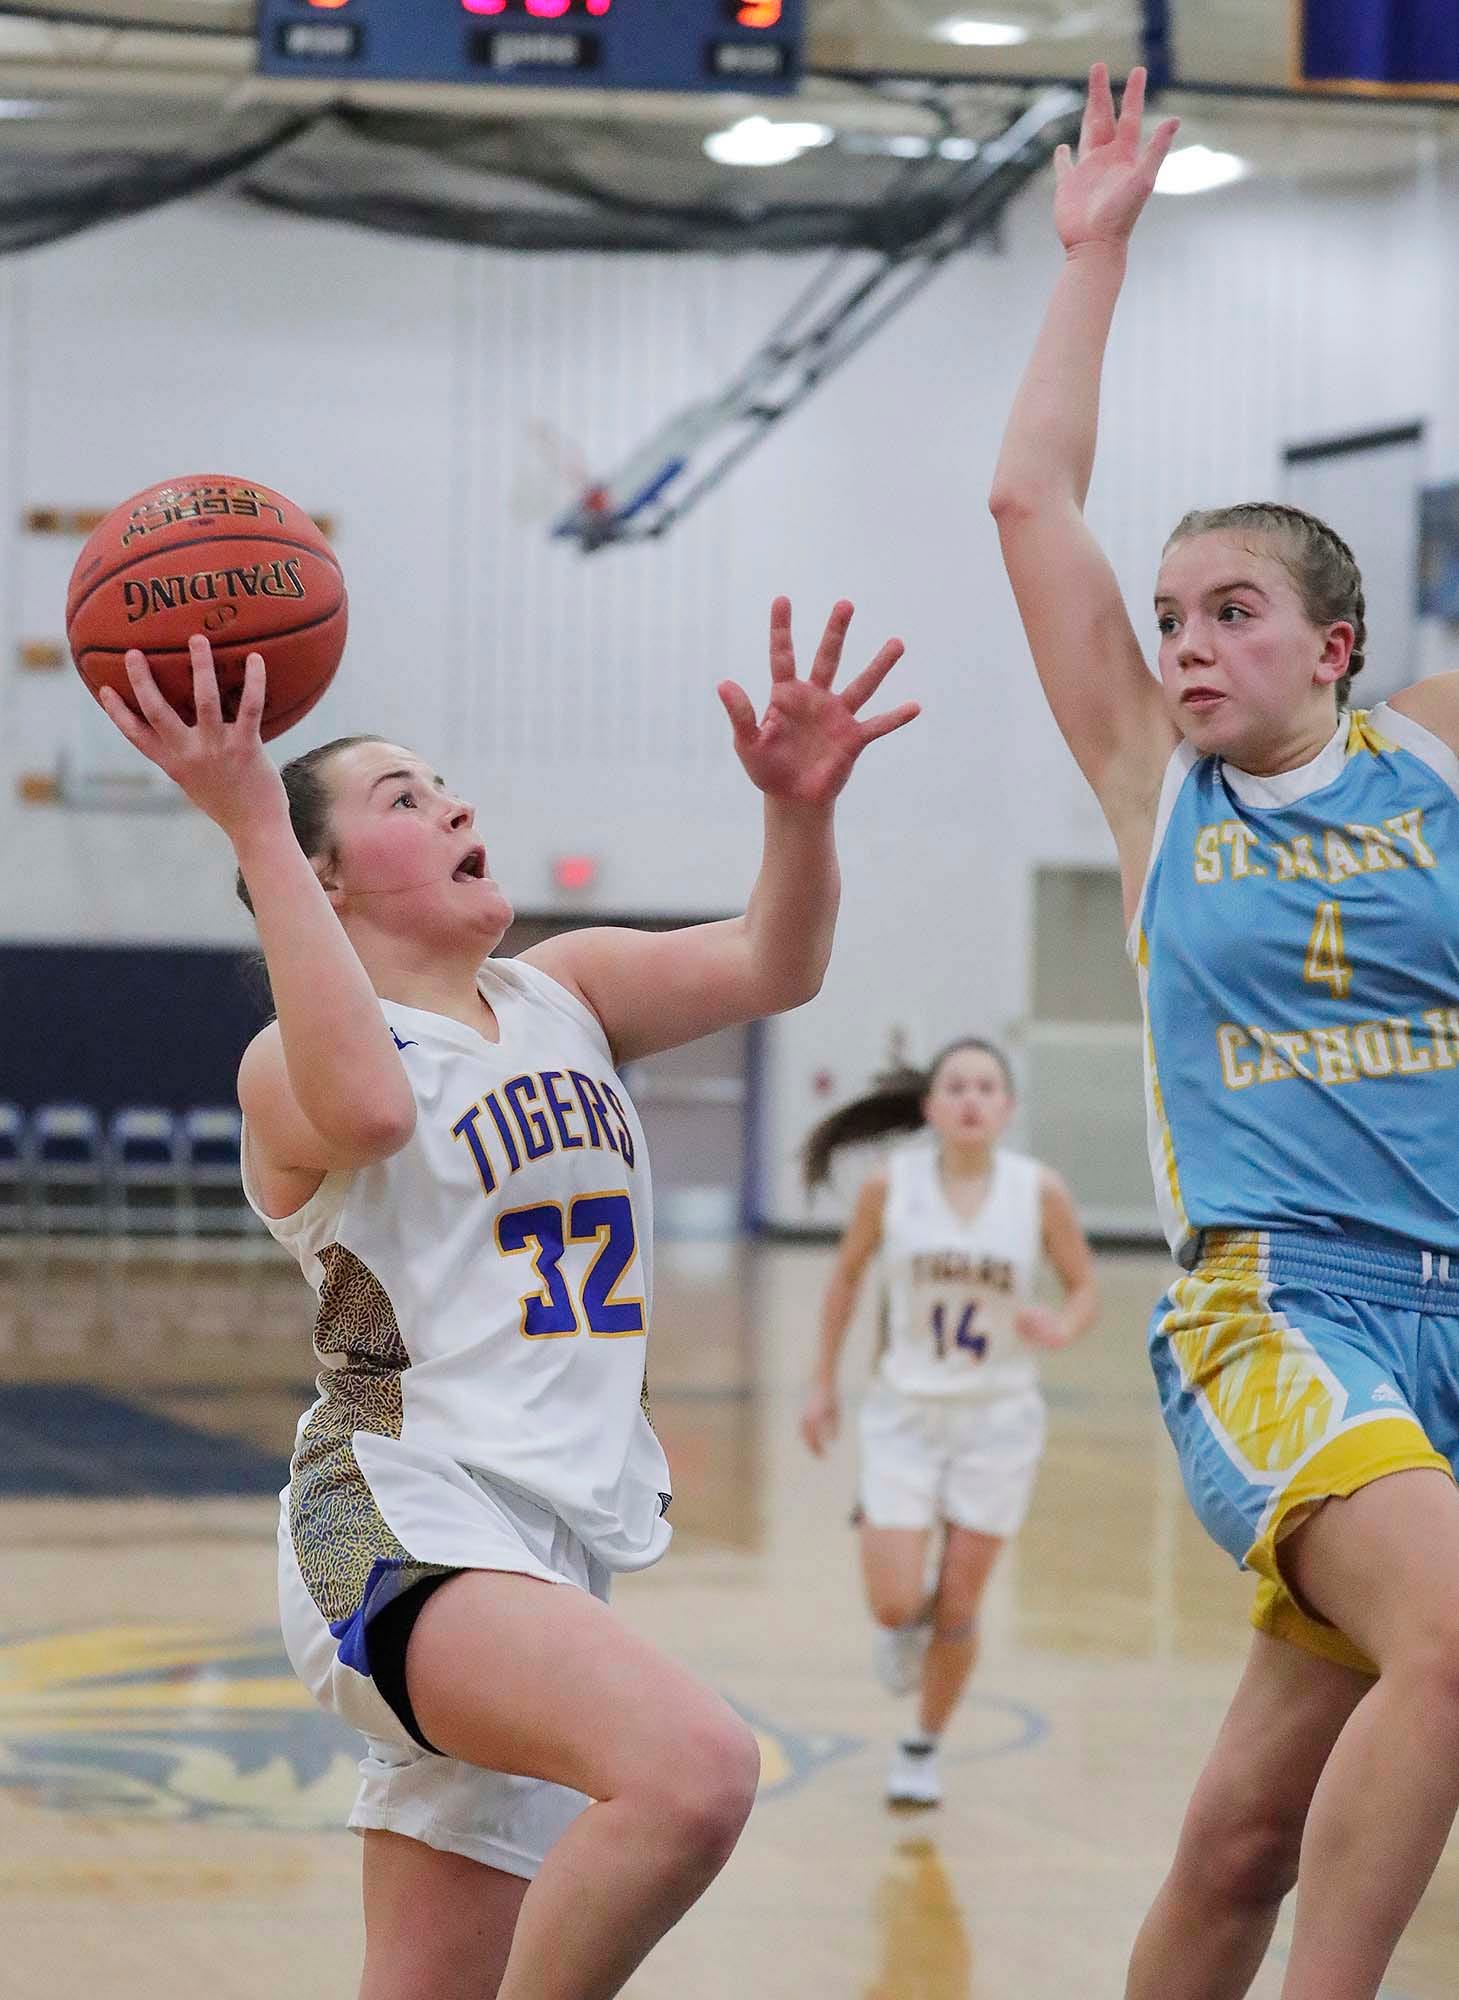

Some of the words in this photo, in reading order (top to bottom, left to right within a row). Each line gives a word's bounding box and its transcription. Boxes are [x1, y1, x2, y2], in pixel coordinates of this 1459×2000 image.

[120, 493, 286, 548] LEGACY
[123, 557, 305, 623] SPALDING
[1194, 820, 1267, 884] ST.
[1269, 808, 1437, 883] MARY
[1304, 901, 1353, 999] 4
[450, 1068, 635, 1198] TIGERS
[493, 1189, 647, 1339] 32
[930, 1301, 988, 1363] 14
